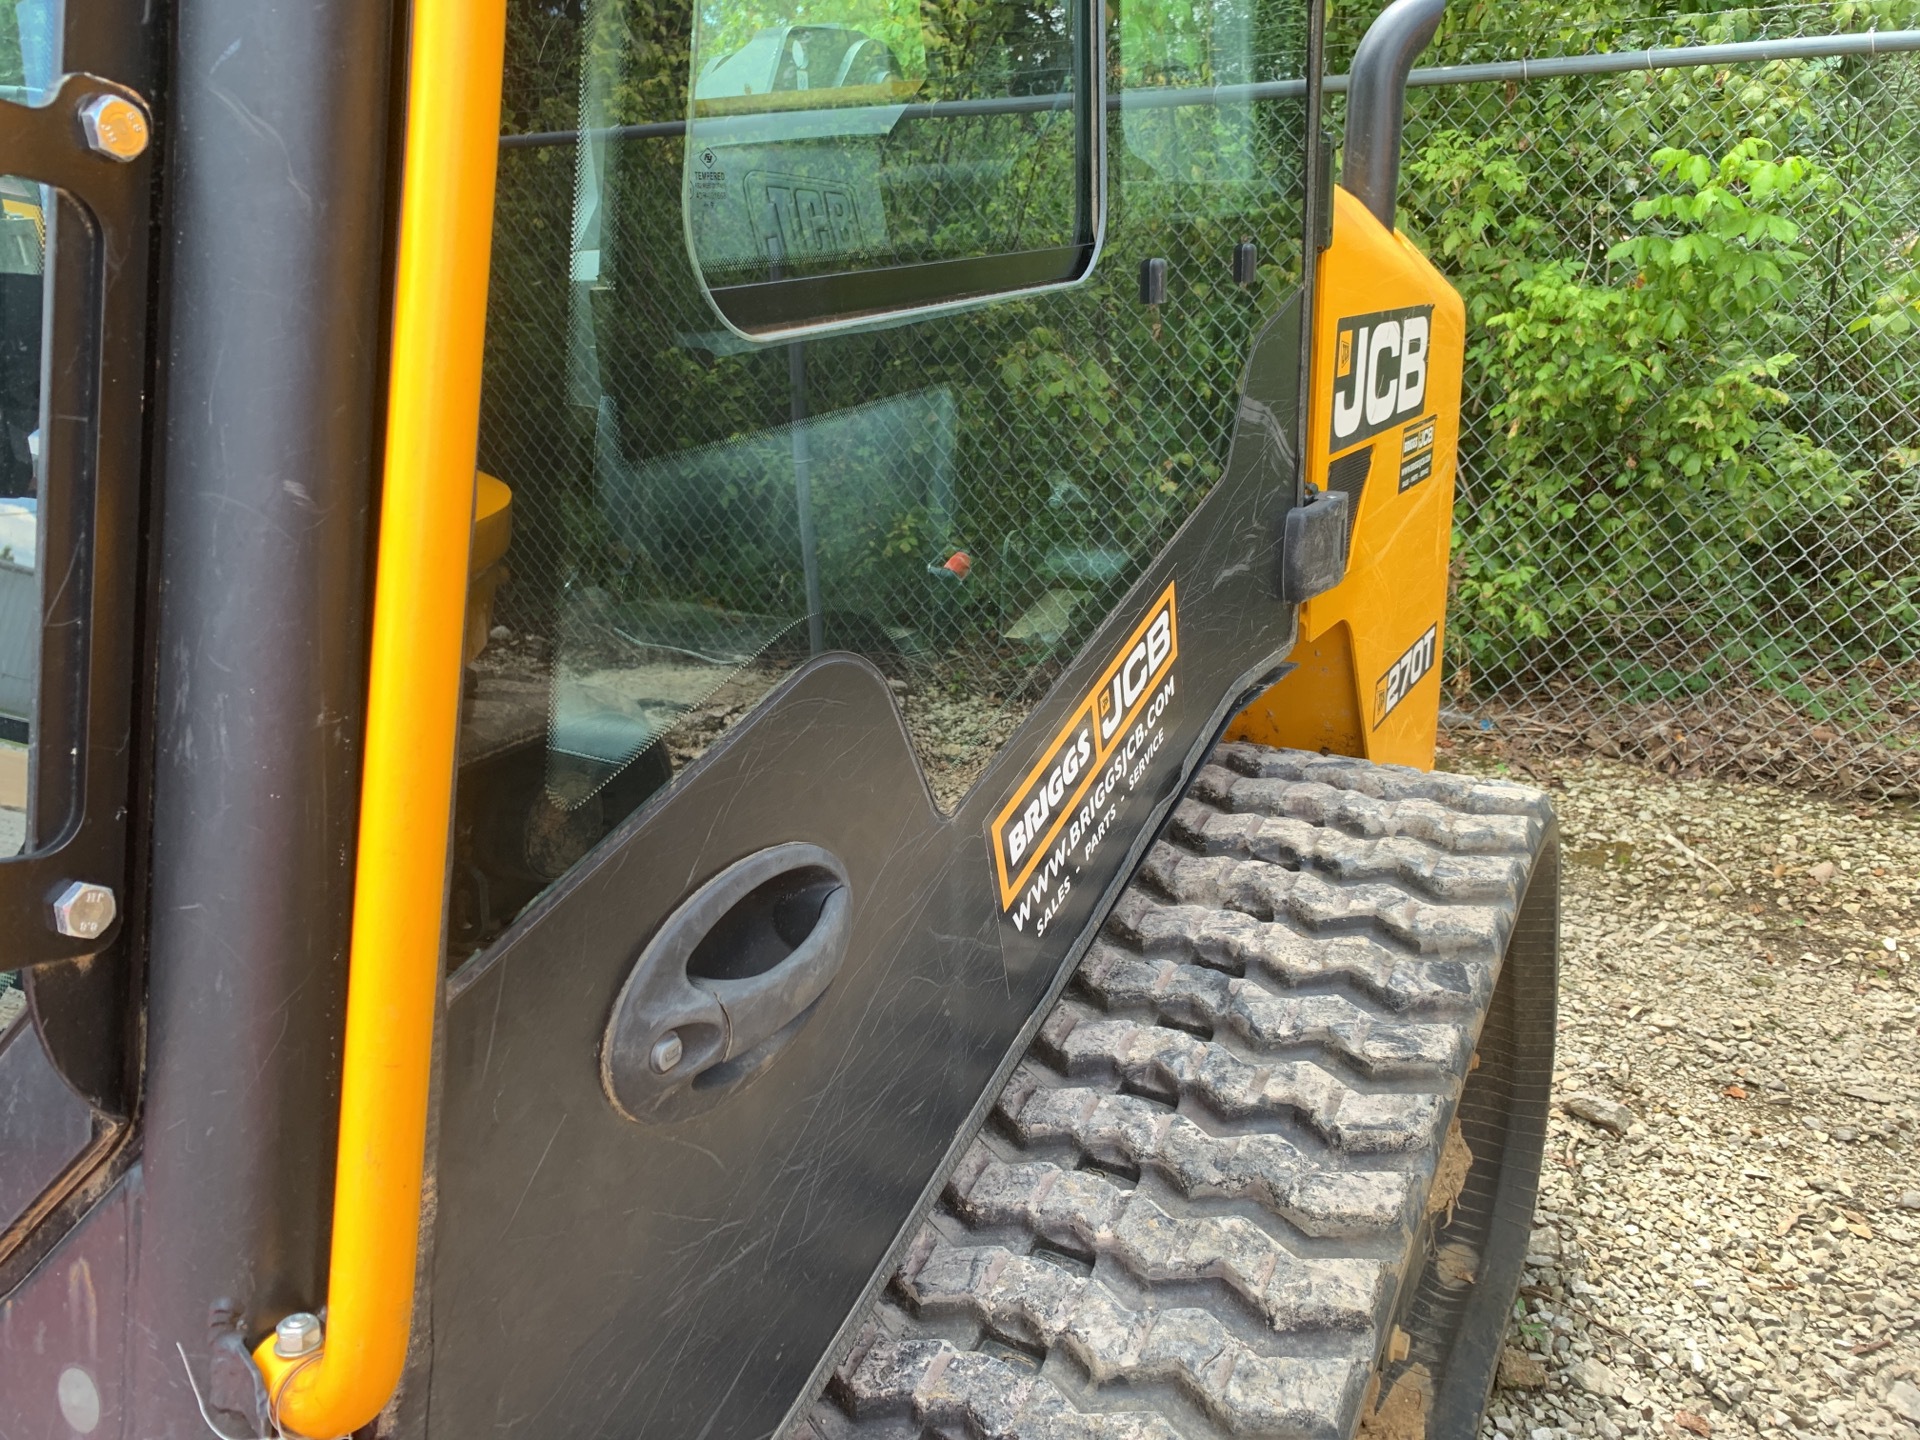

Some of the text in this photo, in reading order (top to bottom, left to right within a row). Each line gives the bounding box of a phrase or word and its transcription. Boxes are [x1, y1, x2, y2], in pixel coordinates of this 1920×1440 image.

[694, 171, 726, 181] TEMPERED
[1334, 316, 1428, 437] JCB
[1008, 609, 1173, 866] BRIGGS JCB
[1386, 626, 1436, 714] 270T
[1012, 675, 1176, 933] WWW.BRIGGSJCB.COM
[1037, 882, 1071, 938] SALES
[1085, 808, 1116, 860] PARTS
[1128, 726, 1165, 790] SERVICE
